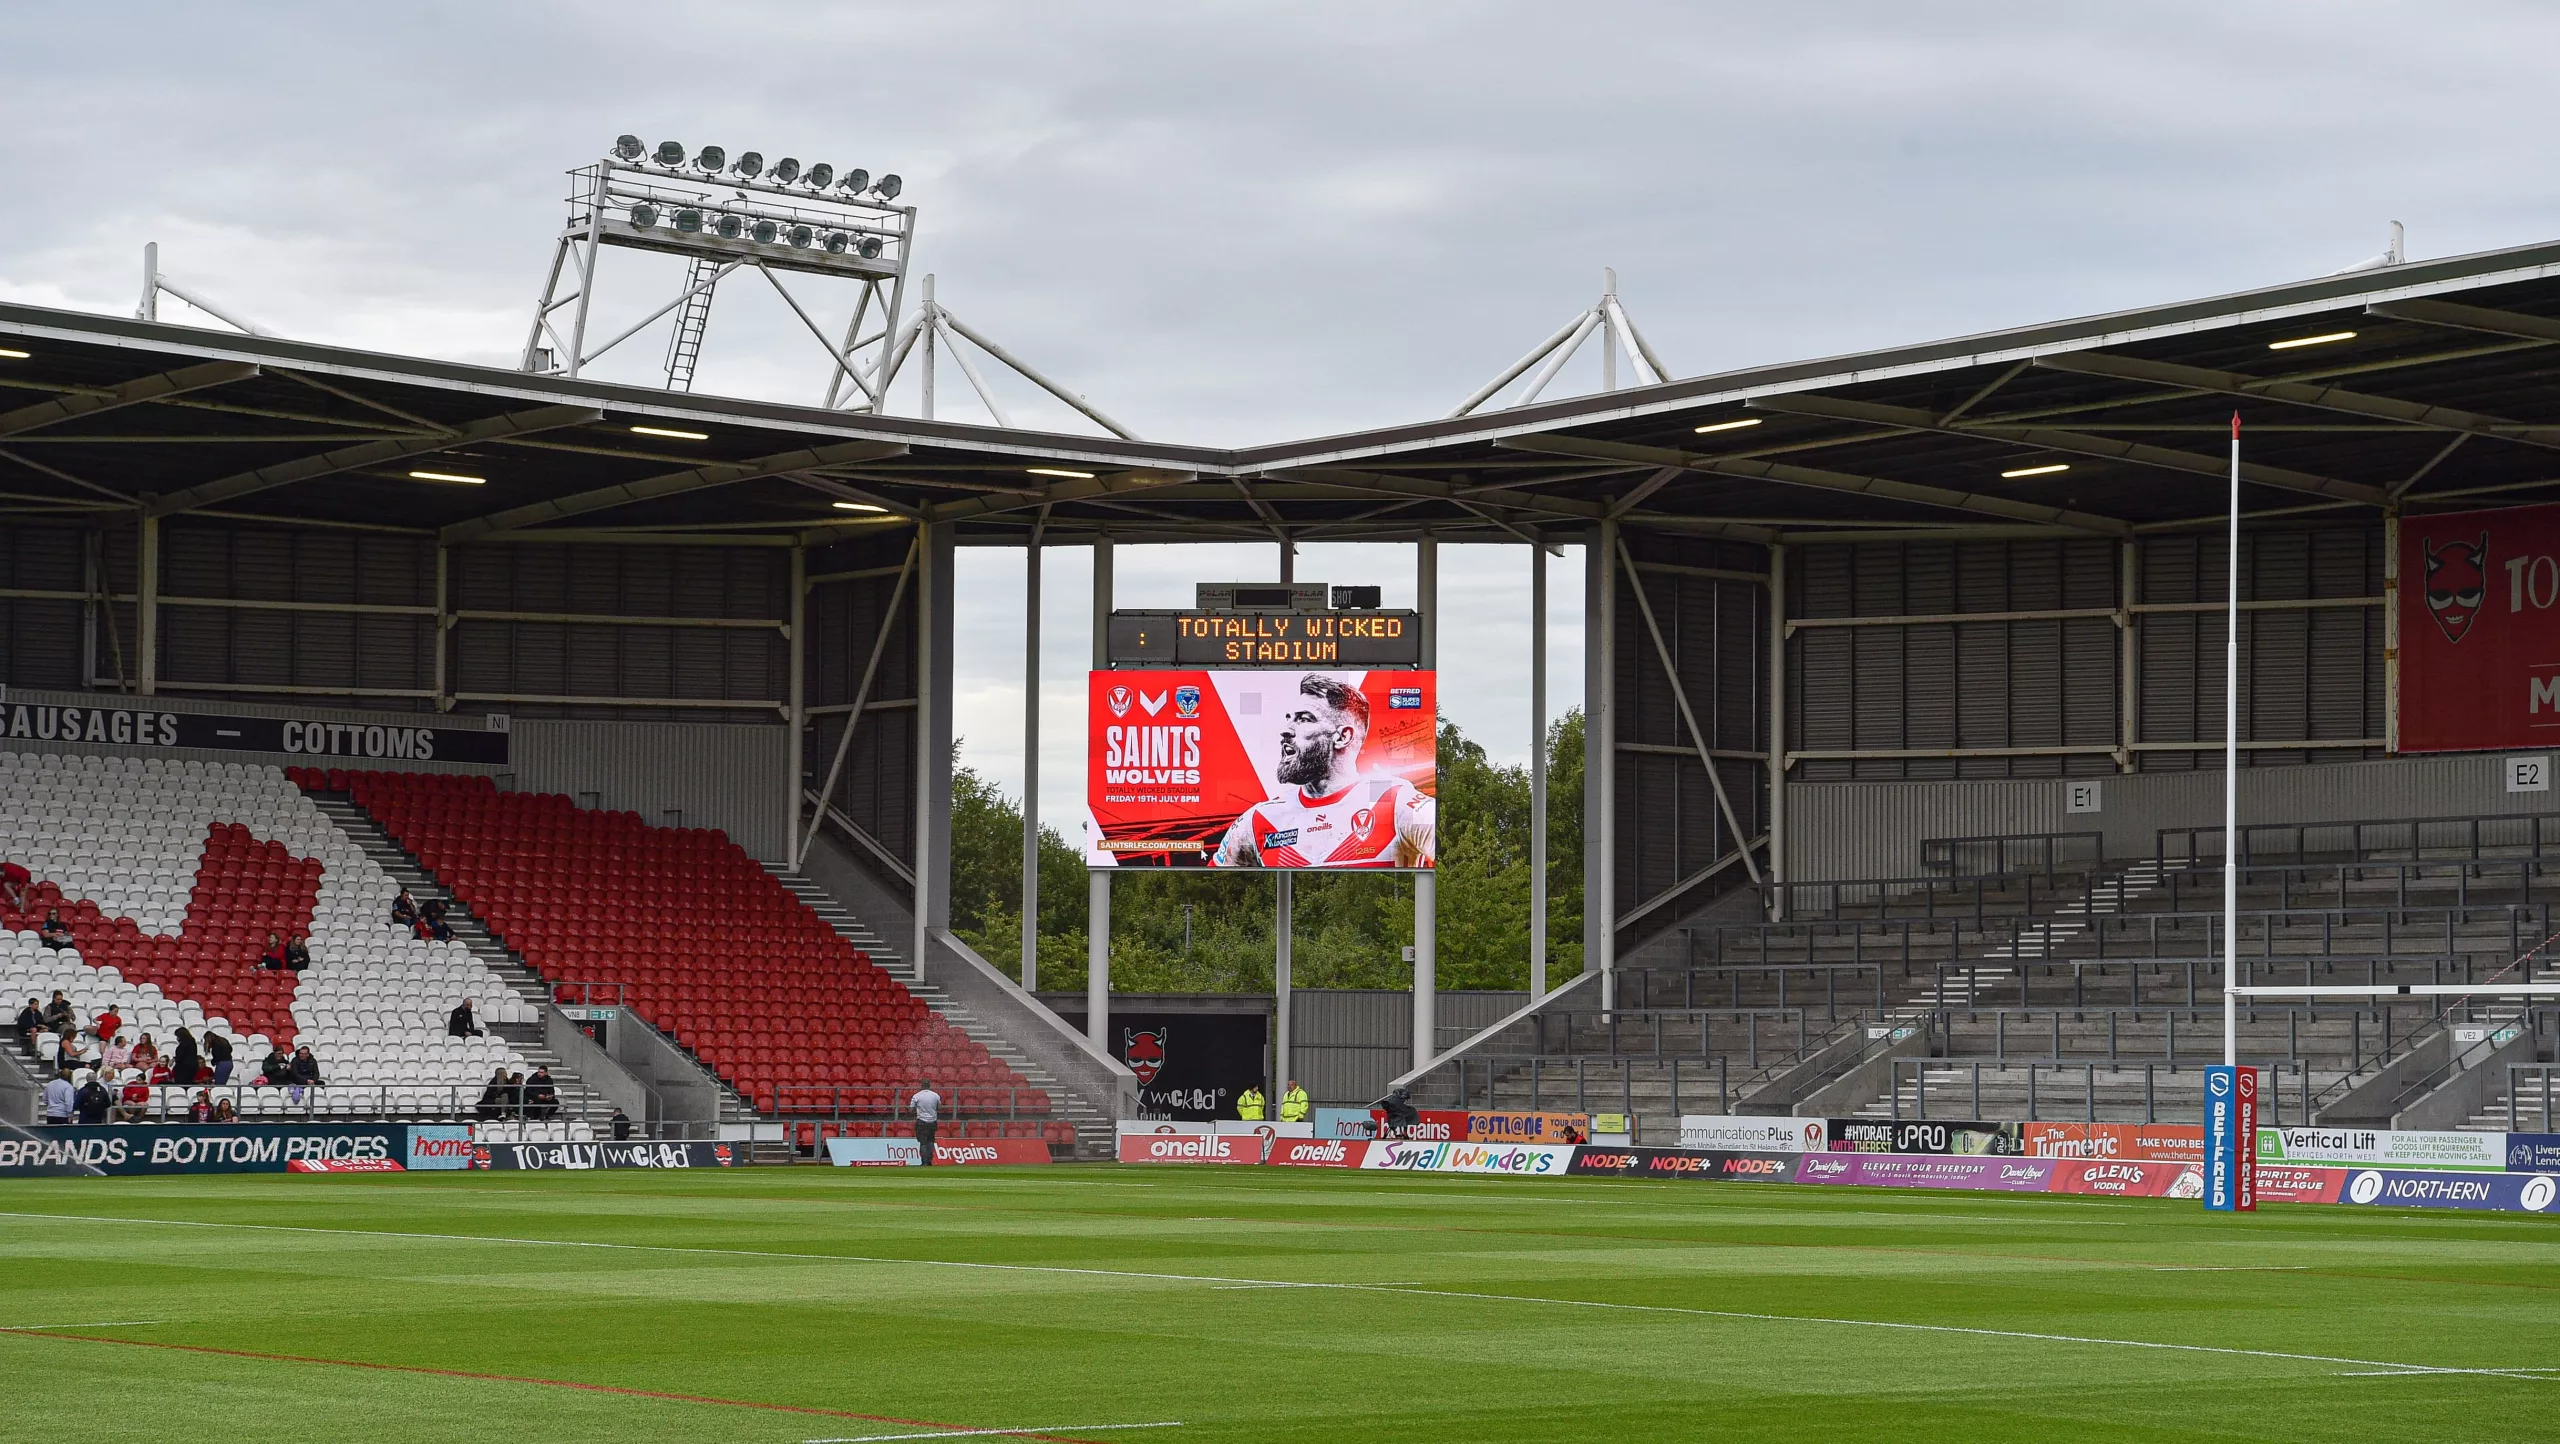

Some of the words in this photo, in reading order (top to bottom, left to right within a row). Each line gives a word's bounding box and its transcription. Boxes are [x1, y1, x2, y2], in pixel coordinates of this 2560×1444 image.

[1179, 618, 1288, 637] TOTALLY
[1306, 618, 1401, 637] WICKED
[1226, 641, 1336, 660] STADIUM
[283, 721, 434, 760] COTTOMS
[1106, 725, 1200, 767] SAINTS
[1105, 769, 1200, 785] WOLVES
[2516, 763, 2539, 785] E2
[1106, 795, 1136, 803] FRIDAY
[1138, 795, 1157, 803] 19TH
[1159, 795, 1179, 803] JULY
[1180, 795, 1200, 803] 8PM
[2074, 788, 2091, 807] E1
[1100, 841, 1202, 849] SAINTSRLFC.COM/TICKETS
[2463, 1032, 2476, 1040] VE2
[1550, 1118, 1568, 1126] YOUR
[1571, 1118, 1586, 1126] RIDE
[1768, 1126, 1794, 1141] Plus
[1844, 1125, 1892, 1141] #HYDRATE
[2047, 1129, 2065, 1139] The
[2284, 1130, 2348, 1150] Vertical
[2354, 1132, 2376, 1150] Lift
[2439, 1136, 2477, 1144] PASSENGER
[0, 1137, 128, 1166] BRANDS
[151, 1136, 281, 1164] BOTTOM
[285, 1135, 389, 1162] PRICES
[413, 1135, 473, 1157] home
[886, 1143, 924, 1159] hom
[2033, 1132, 2118, 1157] Turmeric
[2136, 1138, 2160, 1148] TAKE
[2162, 1138, 2187, 1148] YOUR
[1378, 1142, 1451, 1169] Small
[1580, 1154, 1639, 1168] NODE4
[2212, 1101, 2226, 1207] BETFRED
[2241, 1102, 2252, 1207] BETFRED
[2288, 1151, 2325, 1160] SERVICES
[2327, 1152, 2353, 1160] NORTH
[2438, 1152, 2468, 1160] MOVING
[1649, 1156, 1711, 1172] NODE4
[1722, 1158, 1786, 1174] NODE4
[1862, 1162, 1902, 1171] ELEVATE
[1906, 1164, 1932, 1172] YOUR
[1936, 1164, 1985, 1173] EVERYDAY
[2084, 1165, 2144, 1184] GLEN'S
[2294, 1172, 2310, 1180] OF
[2094, 1182, 2126, 1191] VODKA
[2256, 1180, 2272, 1188] ER
[2276, 1180, 2324, 1190] LEAGUE
[2386, 1179, 2490, 1200] NORTHERN
